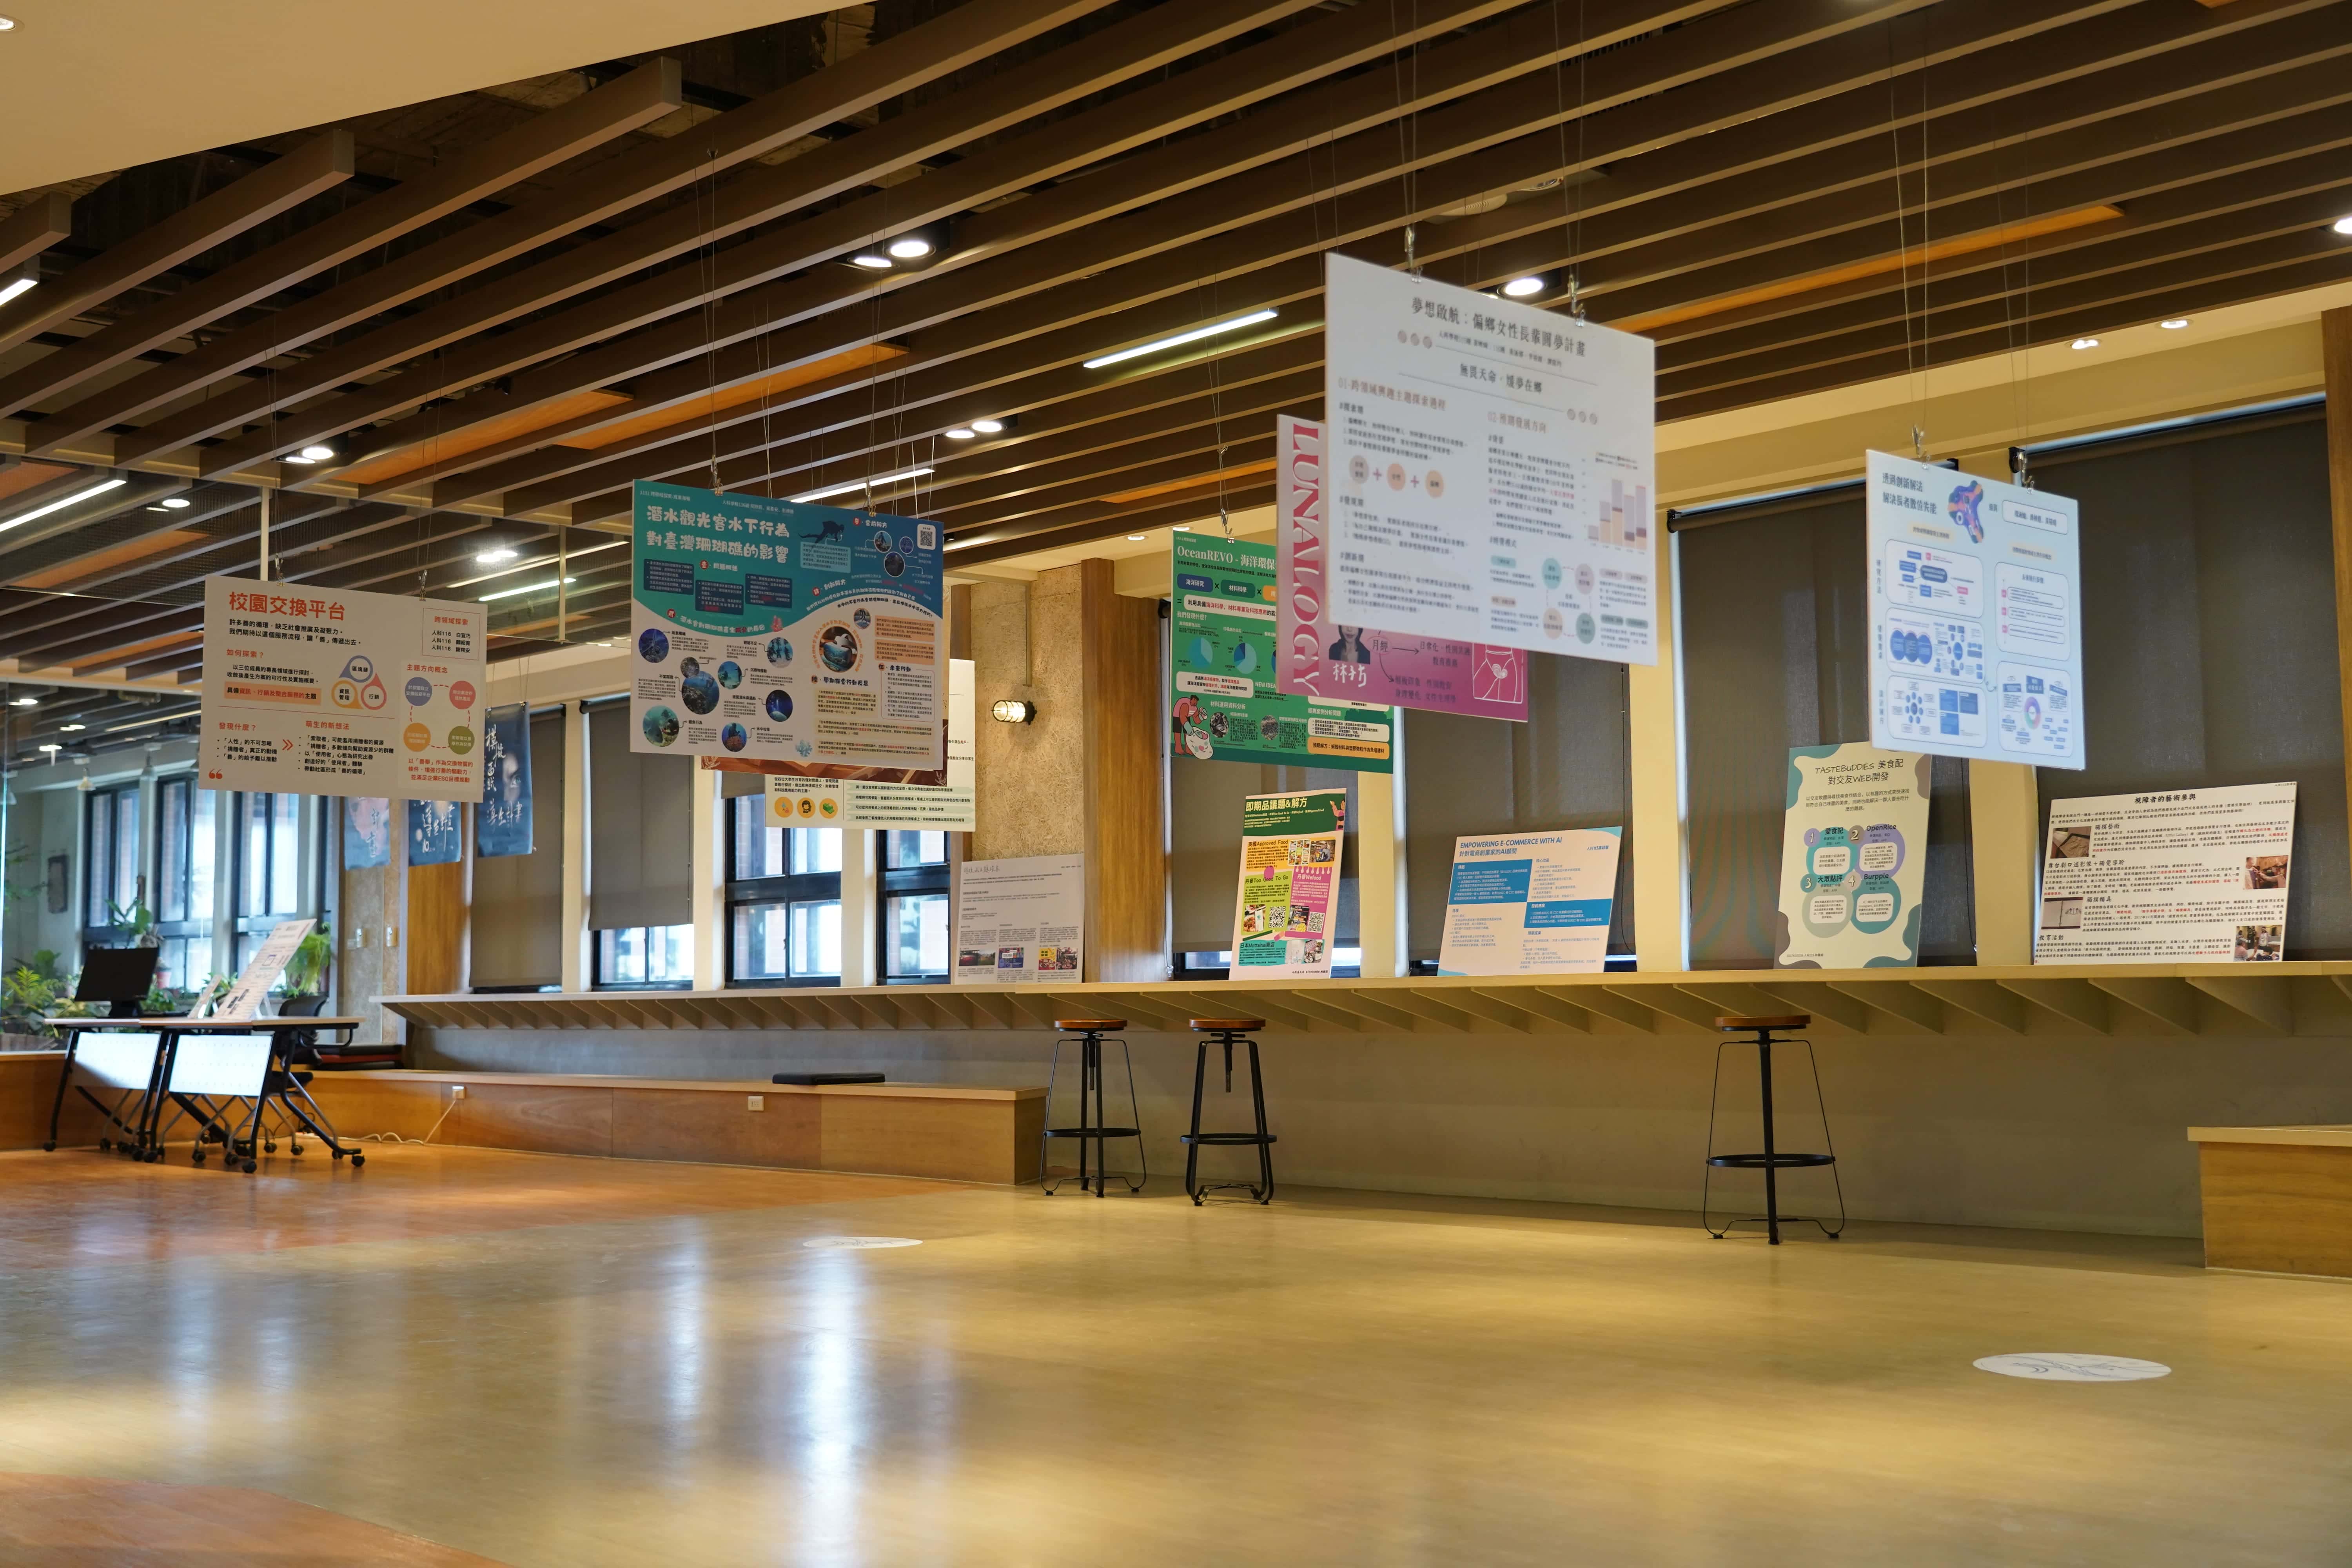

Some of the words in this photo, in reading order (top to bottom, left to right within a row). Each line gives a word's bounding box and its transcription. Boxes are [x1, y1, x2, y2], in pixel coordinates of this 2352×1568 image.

[647, 505, 790, 538] 潛水觀光客水下行為
[646, 530, 789, 563] 對臺灣珊瑚礁的影響
[1177, 545, 1233, 564] OceanREVO
[1241, 554, 1276, 571] 海洋環保
[1292, 423, 1320, 696] LUNALOGY
[1186, 578, 1205, 588] 海洋研究
[1229, 584, 1247, 593] 材料科學
[229, 591, 345, 621] 校園交換平台
[434, 616, 468, 626] 跨領域探索
[1372, 640, 1388, 653] 月經
[407, 664, 448, 673] 主題方向概念
[305, 720, 350, 730] 萌生的新想法
[1815, 762, 1875, 774] TASTEBUDDIES
[1878, 758, 1904, 769] 美食配
[1828, 771, 1889, 785] 對交友WEB開發
[1245, 797, 1308, 812] 即期品議題&解方
[2135, 793, 2196, 804] 視障者的藝術參與
[1825, 827, 1844, 835] 愛食記
[1866, 824, 1897, 833] OpenRice
[1809, 831, 1815, 844] 1
[1850, 829, 1859, 841] 2
[1460, 840, 1499, 849] EMPOWERING
[1500, 838, 1539, 847] E-COMMERCE
[1805, 877, 1812, 889] 3
[1848, 875, 1856, 887] 4
